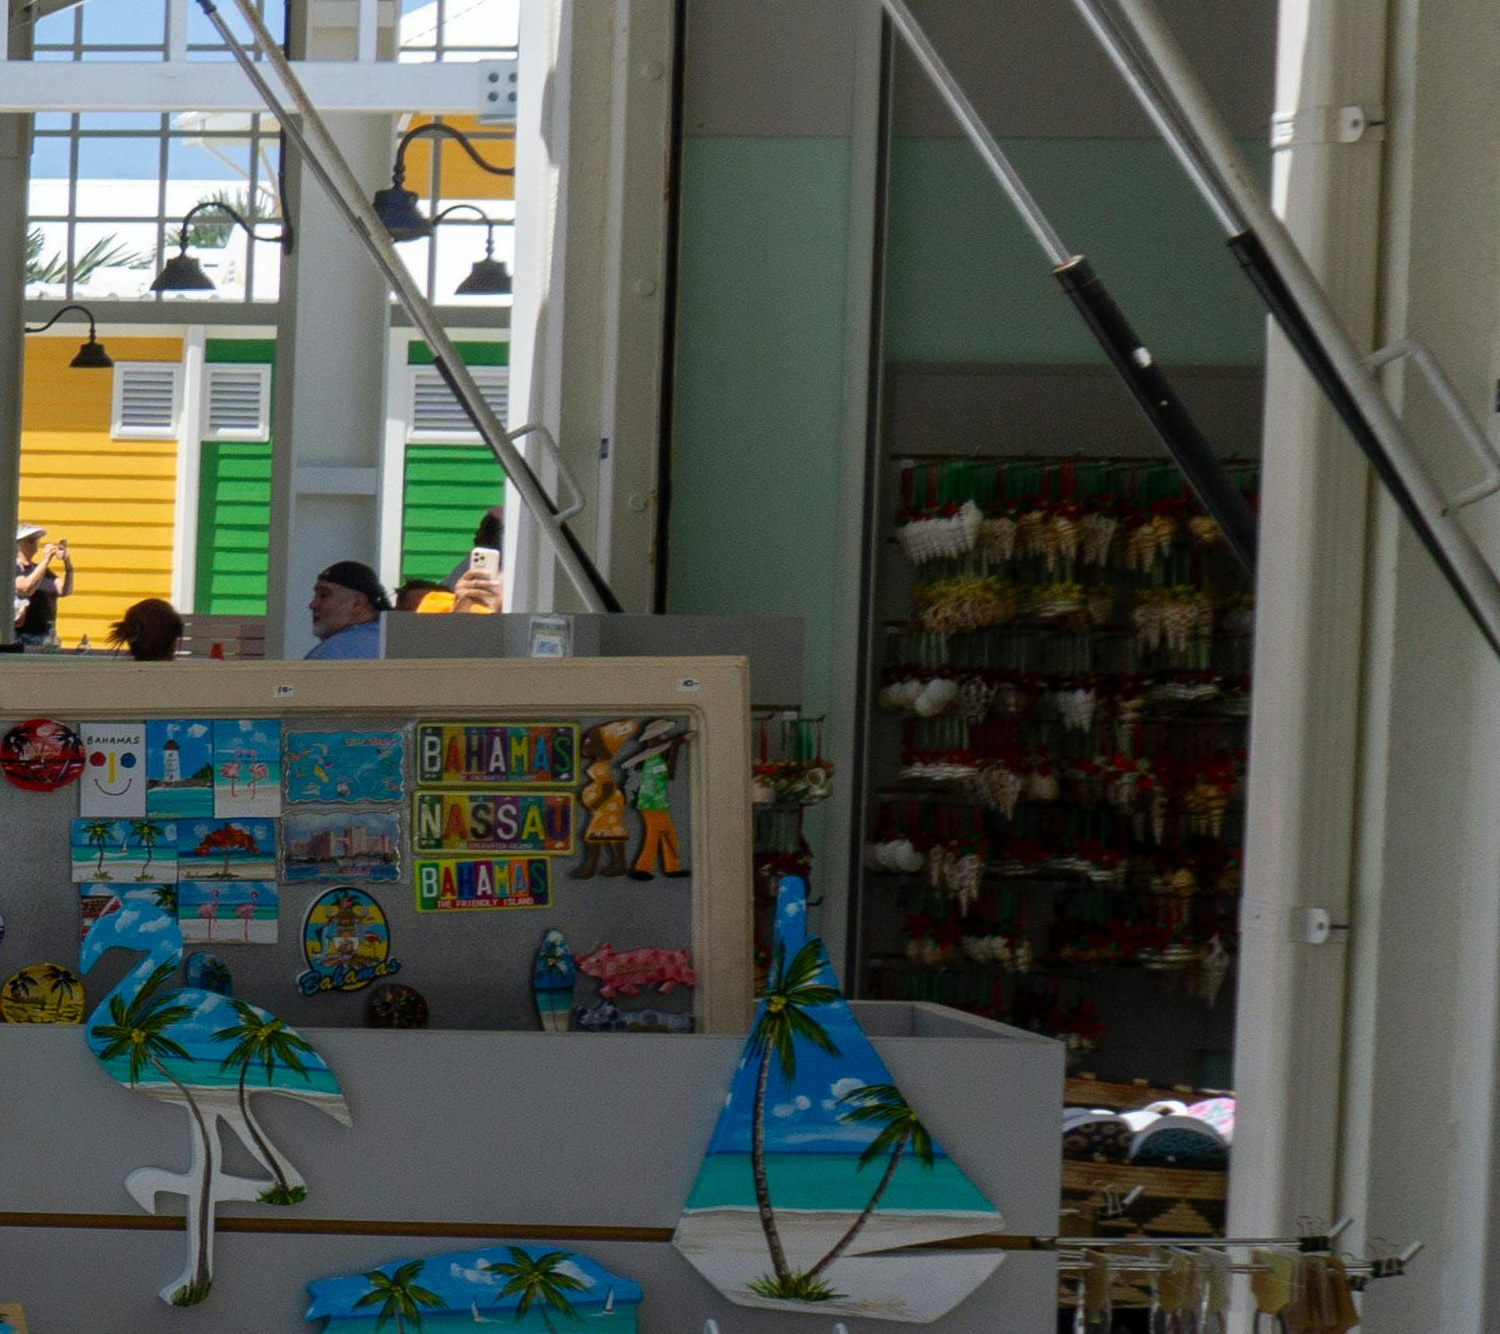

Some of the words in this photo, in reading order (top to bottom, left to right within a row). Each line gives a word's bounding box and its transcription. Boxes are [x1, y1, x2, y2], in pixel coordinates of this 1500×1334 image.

[87, 735, 140, 746] BAHAMAS
[422, 733, 573, 774] BAHAMAS
[419, 802, 570, 842] NASSAU
[421, 862, 546, 899] BAHAMAS
[436, 899, 452, 909] THE
[456, 898, 499, 909] FRIENDLY
[503, 897, 535, 907] ISLAND
[298, 958, 402, 997] Bahamas
